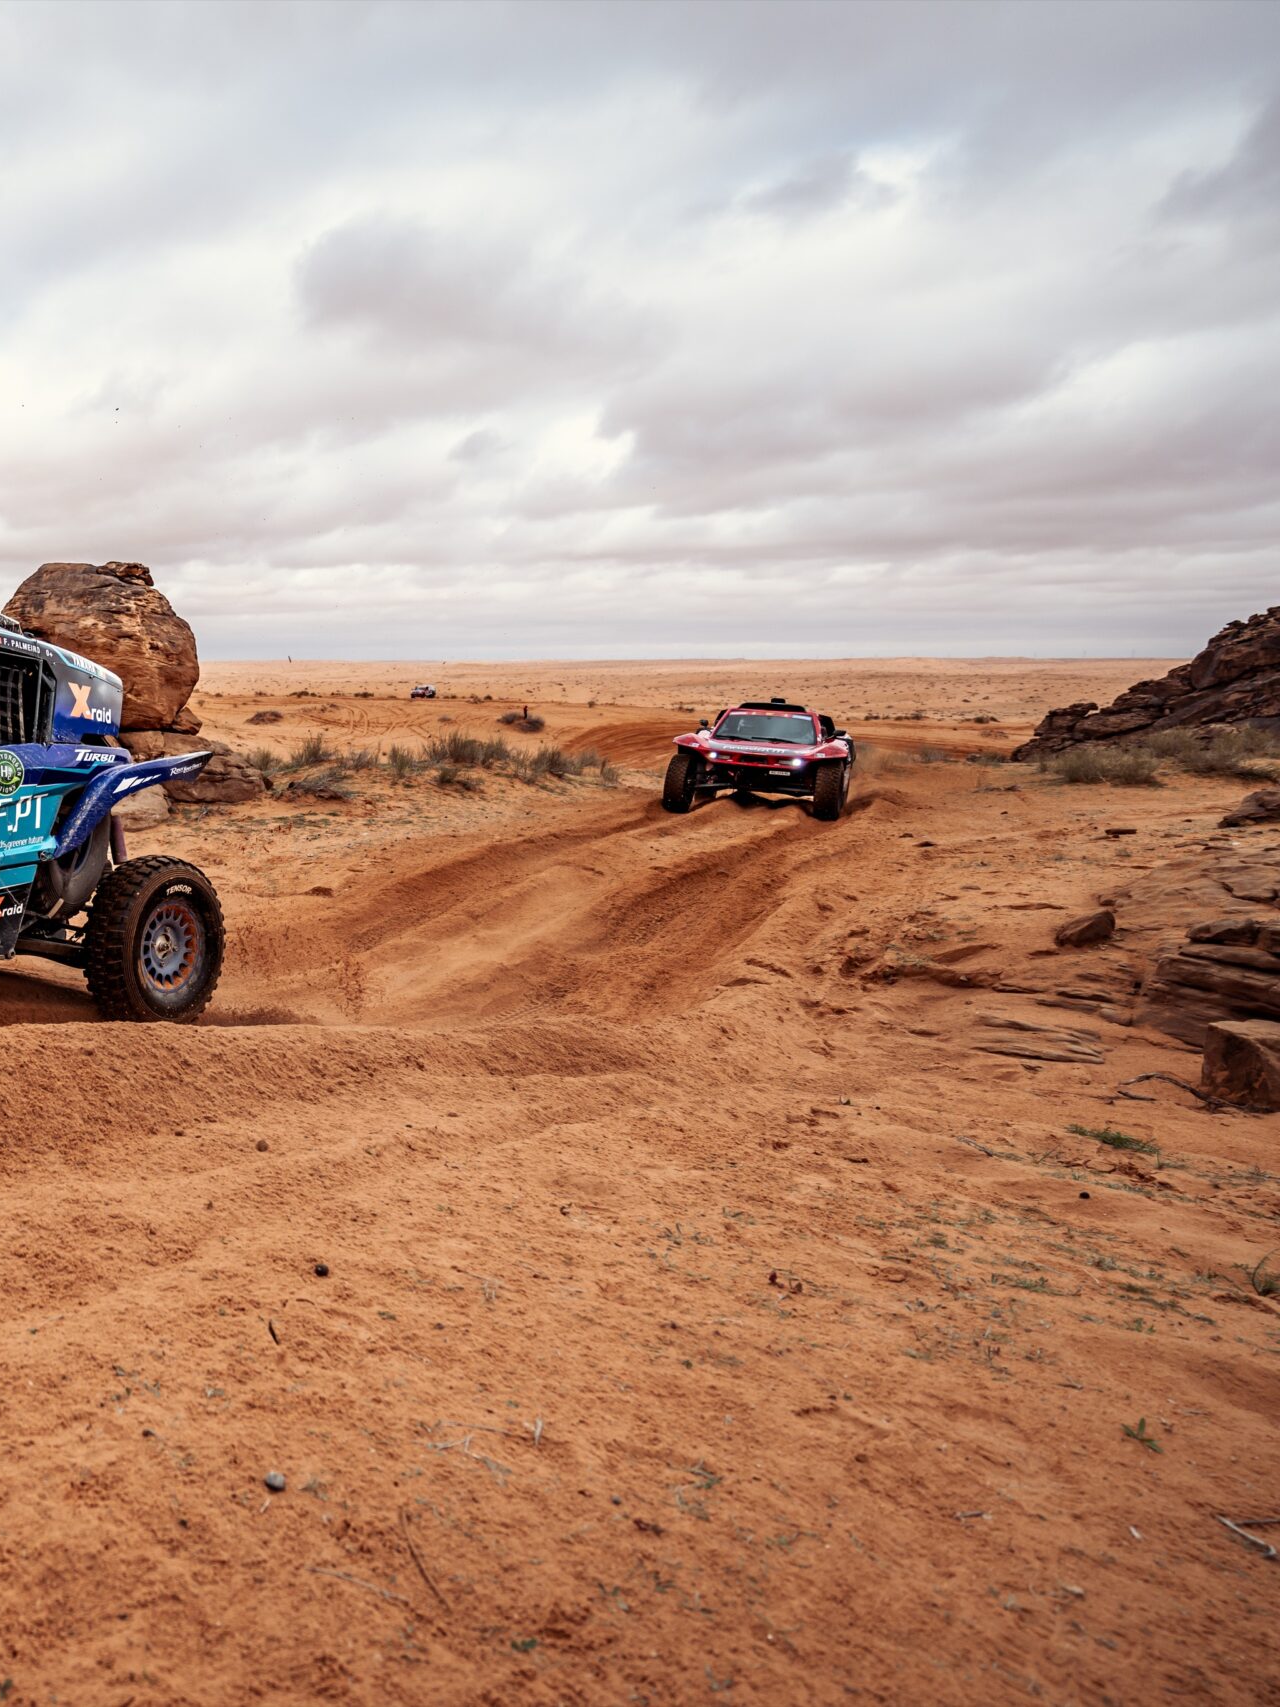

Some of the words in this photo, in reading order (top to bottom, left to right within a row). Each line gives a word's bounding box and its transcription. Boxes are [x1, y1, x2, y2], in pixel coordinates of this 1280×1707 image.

[3, 637, 10, 647] F.
[11, 639, 41, 654] PALMEIRO
[28, 836, 44, 845] future
[165, 884, 193, 896] TENSOR
